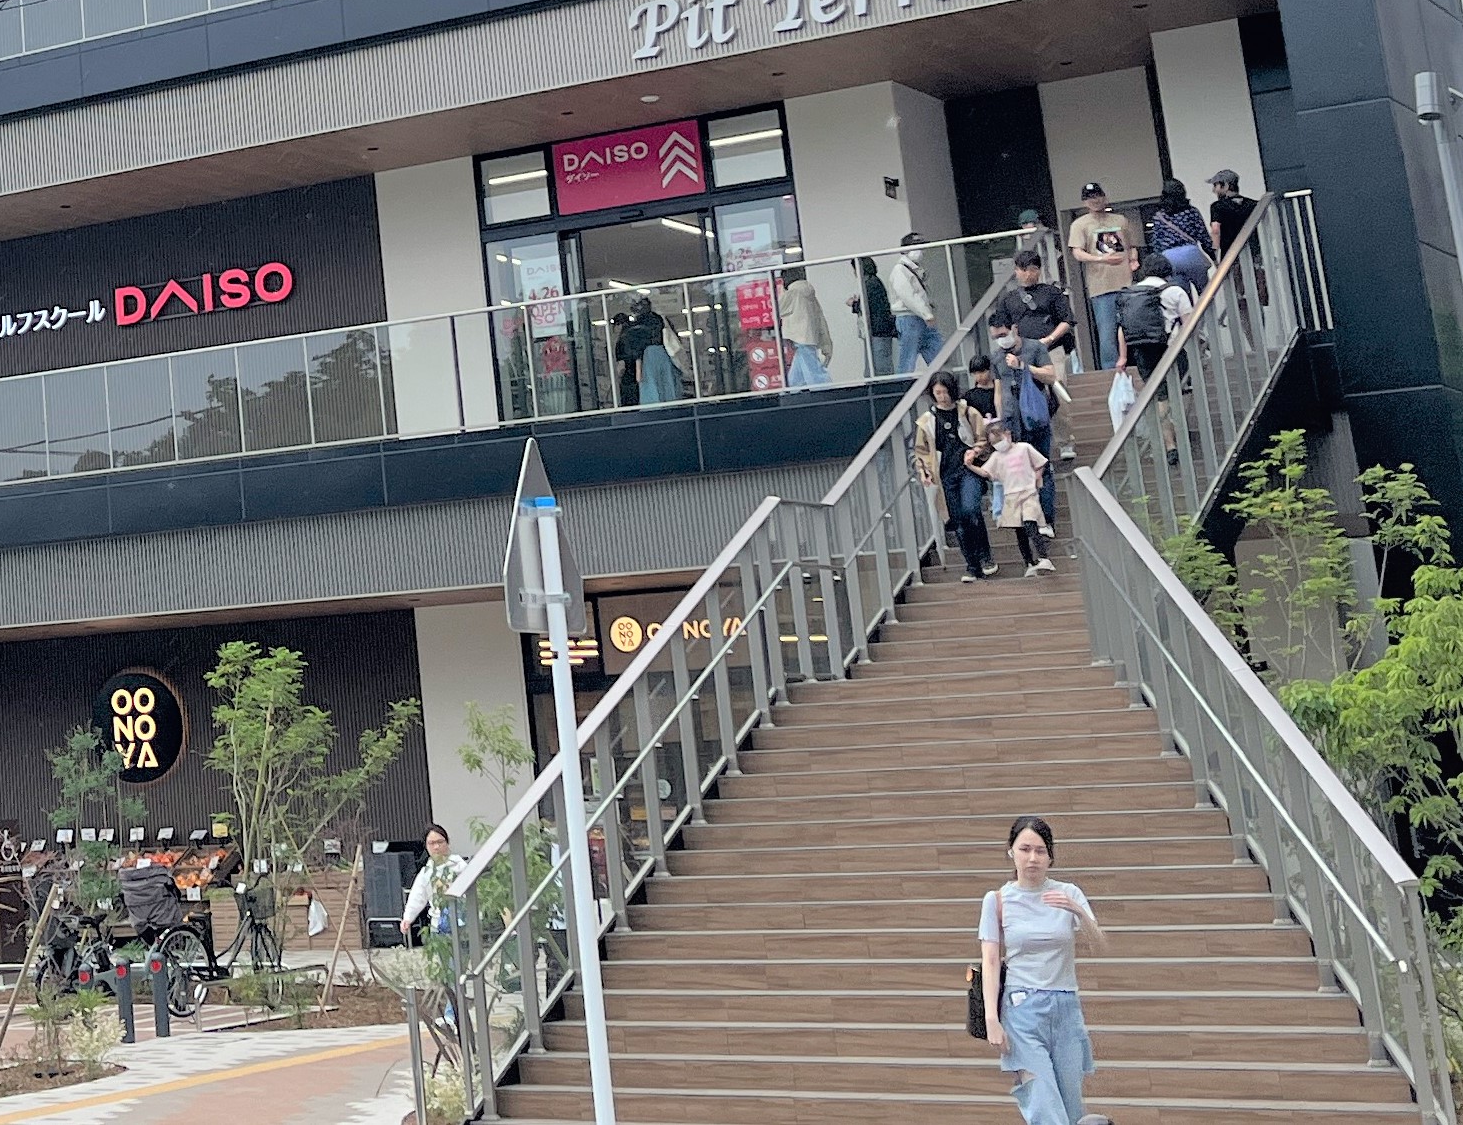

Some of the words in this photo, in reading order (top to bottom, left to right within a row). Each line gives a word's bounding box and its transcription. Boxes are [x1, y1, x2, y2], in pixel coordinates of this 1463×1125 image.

[563, 141, 648, 172] DAISO
[115, 262, 293, 326] DAISO
[111, 687, 156, 715] OO
[113, 714, 157, 742] NO
[115, 741, 159, 769] YA
